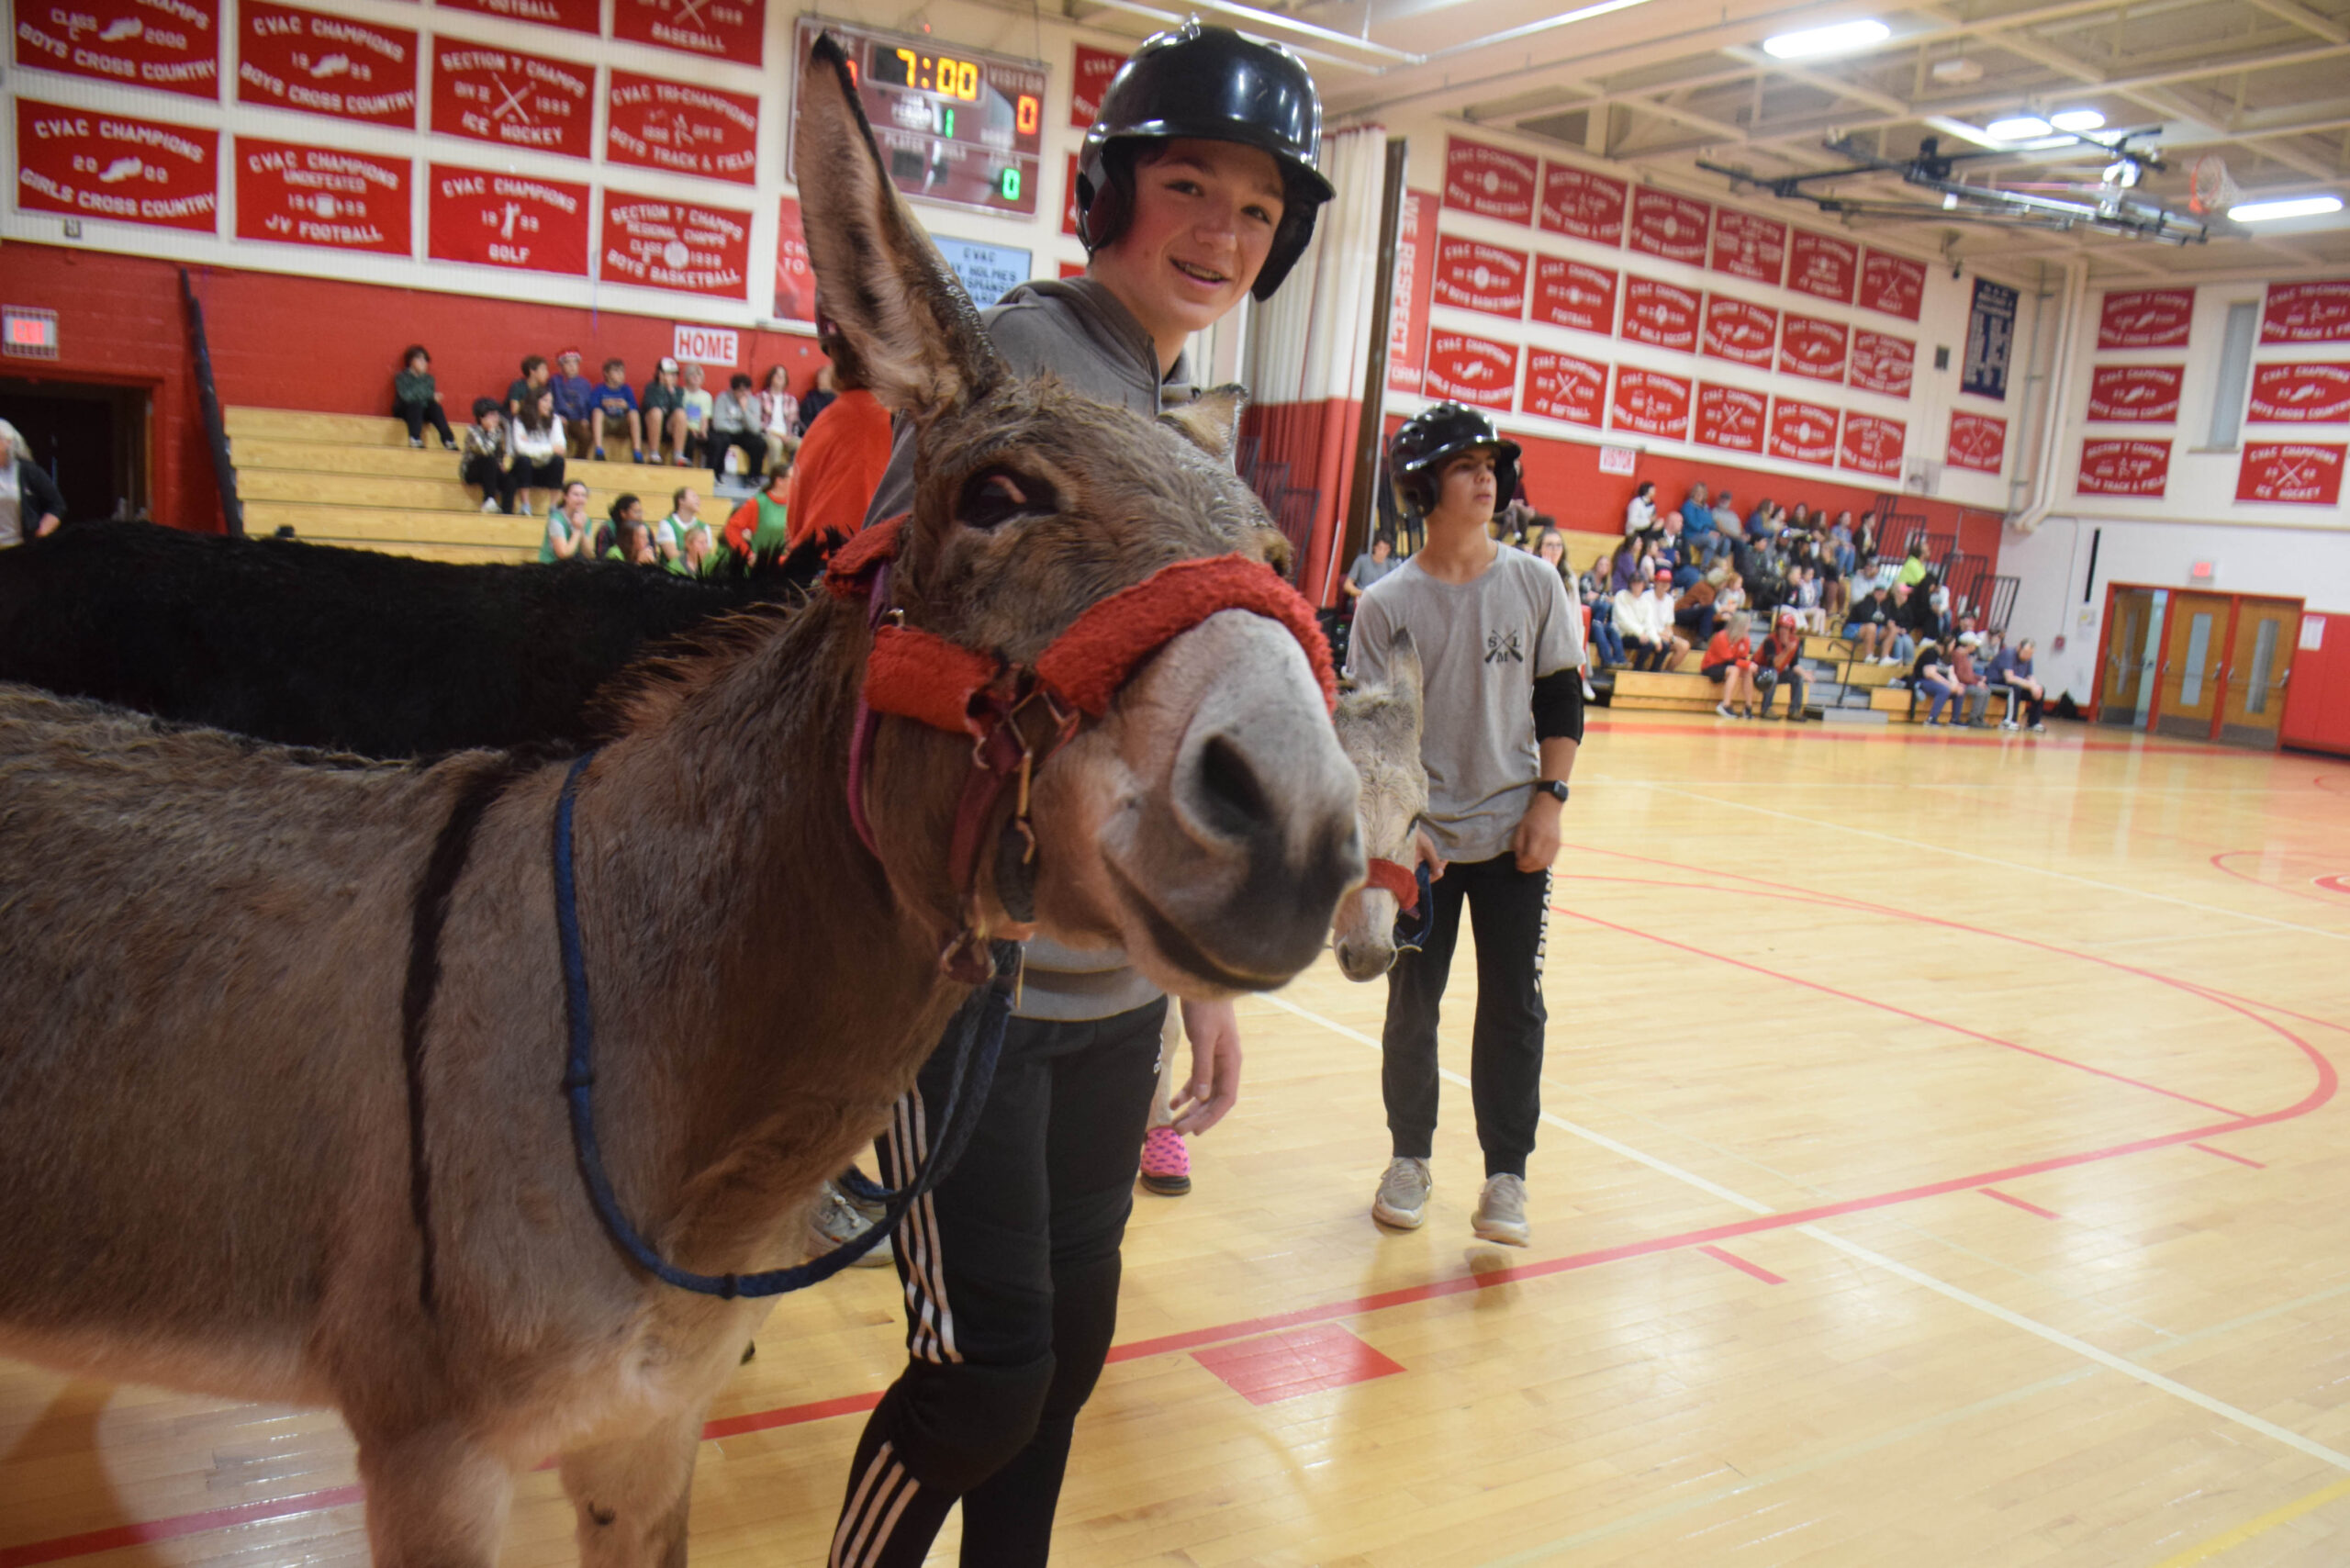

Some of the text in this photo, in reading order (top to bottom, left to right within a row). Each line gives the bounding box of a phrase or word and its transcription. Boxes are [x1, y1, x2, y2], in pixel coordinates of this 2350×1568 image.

[50, 7, 187, 50] CLASS 2000
[253, 15, 405, 63] CVAC CHAMPIONS
[652, 20, 726, 53] BASEBALL
[17, 22, 217, 82] BOYS CROSS COUNTRY
[291, 51, 310, 71] 19
[240, 61, 416, 115] BOYS CROSS COUNTRY
[441, 50, 587, 99] SECTION 7 CHAMPS
[897, 49, 978, 101] 7:00
[990, 65, 1044, 92] VISITOR
[611, 84, 757, 132] CVAC TRI-CHAMPIONS
[946, 108, 955, 138] 1
[1017, 95, 1038, 134] 0
[34, 118, 205, 164] CVAC CHAMPIONS
[462, 110, 563, 145] ICE HOCKEY
[73, 154, 98, 174] 20
[610, 126, 646, 158] BOYS
[654, 144, 698, 170] TRACK
[717, 150, 755, 172] FIELD
[248, 150, 399, 191] CVAC CHAMPIONS
[283, 168, 366, 194] UNDEFEATED
[1002, 168, 1021, 200] 0
[19, 167, 215, 218] GIRLS CROSS COUNTRY
[442, 176, 577, 215] CVAC CHAMPIONS
[265, 213, 385, 244] JV FOOTBALL
[610, 204, 669, 225] SECTION
[689, 208, 744, 242] CHAMPS
[626, 219, 726, 249] REGIONAL CHAMPS
[1404, 196, 1420, 237] WE
[488, 243, 531, 263] GOLF
[630, 239, 663, 257] CLASS
[783, 257, 805, 274] TO
[607, 249, 742, 288] BOYS BASKETBALL
[1391, 241, 1416, 356] RESPECT
[1551, 307, 1593, 328] FOOTBALL
[678, 331, 733, 361] HOME
[1436, 337, 1512, 367] CVAC CHAMPIONS
[2261, 366, 2289, 384] CVAC
[2249, 445, 2338, 465] CVAC CHAMPIONS
[2278, 487, 2321, 499] HOCKEY
[1488, 636, 1497, 648] S
